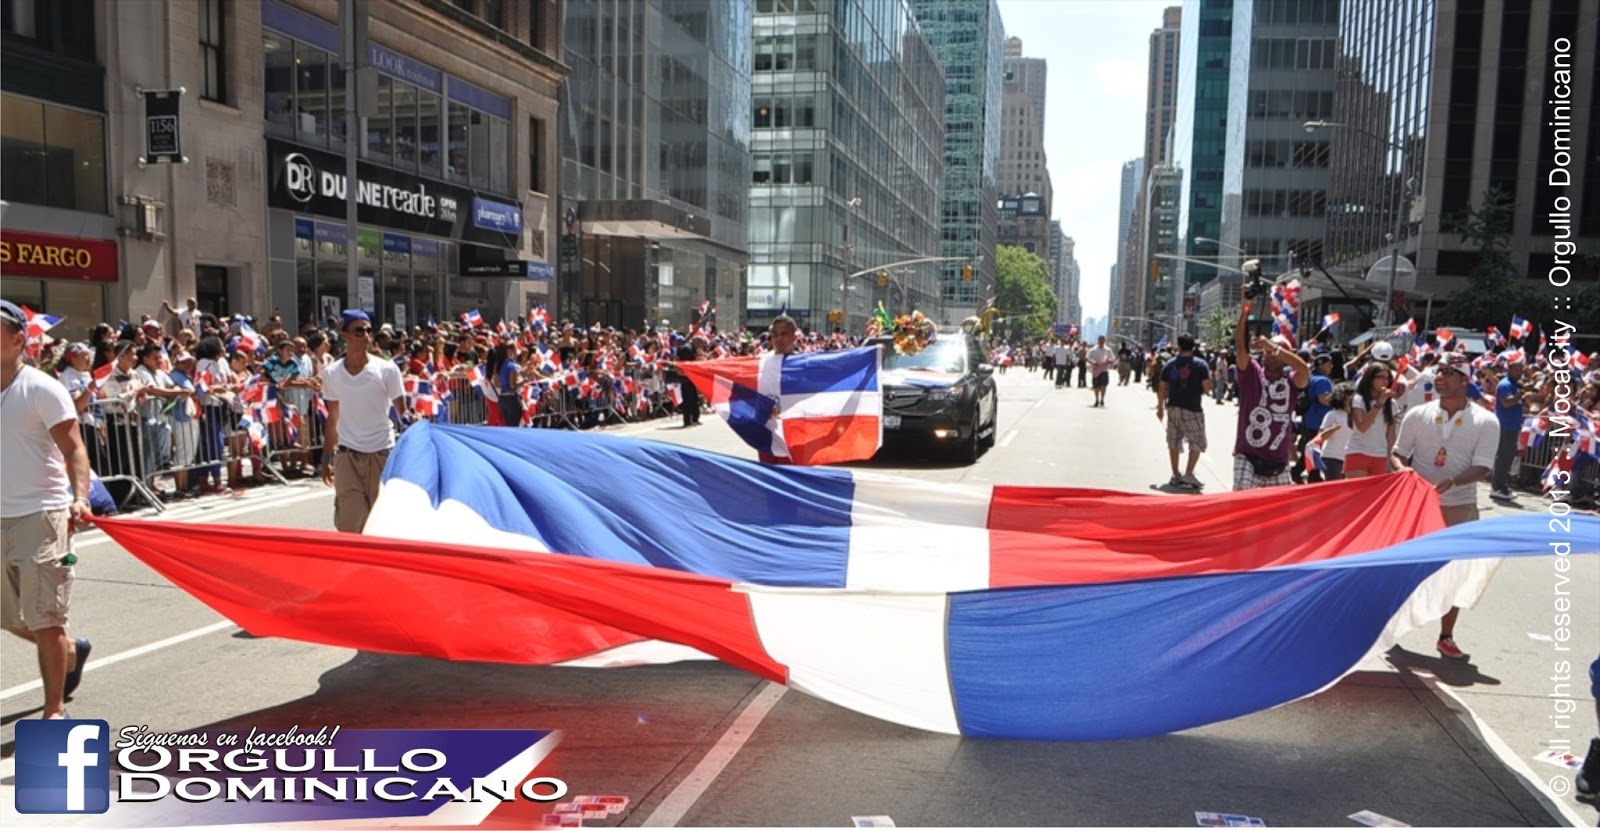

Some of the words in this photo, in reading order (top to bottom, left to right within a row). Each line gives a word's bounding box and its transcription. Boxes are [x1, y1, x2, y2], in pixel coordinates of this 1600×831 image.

[372, 48, 406, 76] LOOK
[151, 119, 174, 133] 1156
[286, 162, 316, 194] DR
[16, 243, 92, 268] FARGO
[1245, 405, 1291, 450] 87
